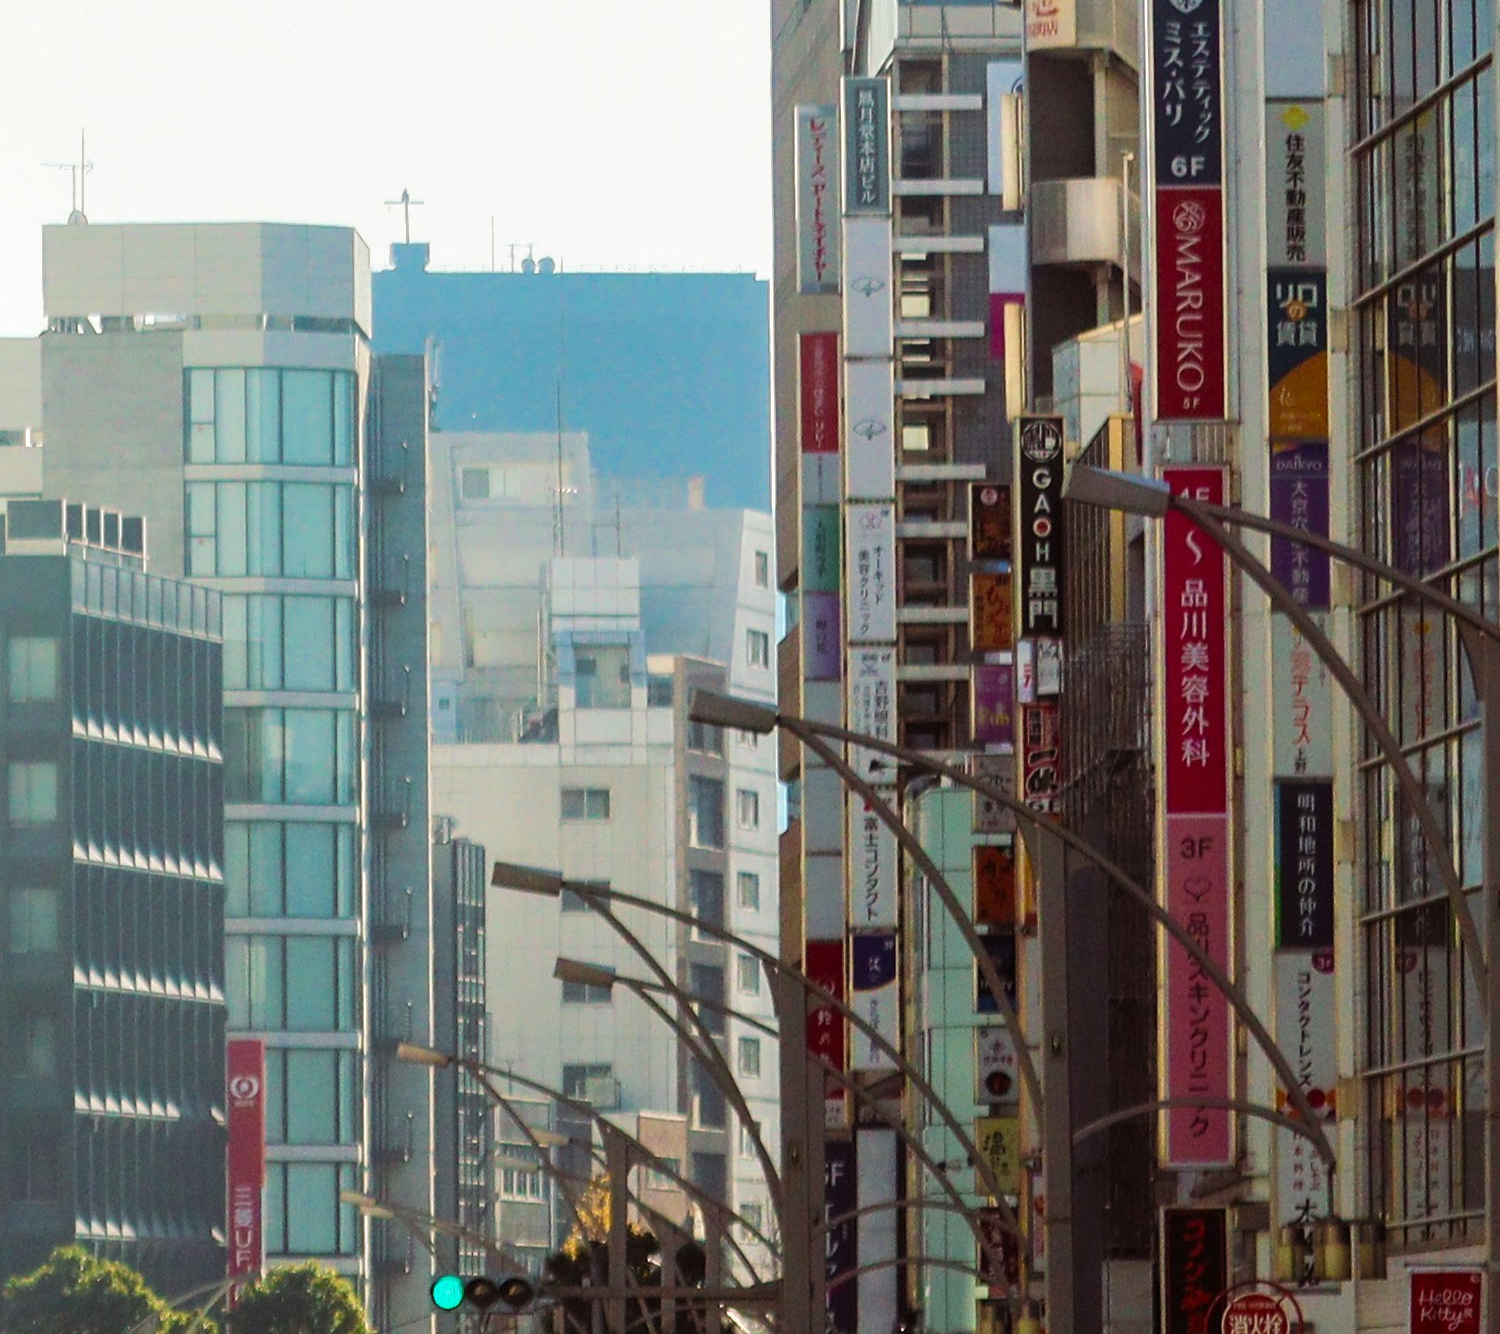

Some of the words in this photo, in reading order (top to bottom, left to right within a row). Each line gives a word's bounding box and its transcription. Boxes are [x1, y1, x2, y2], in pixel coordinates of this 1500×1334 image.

[1161, 22, 1184, 128] ミス・パリ
[1192, 21, 1213, 145] エステティック
[1170, 155, 1206, 178] 6F
[1284, 133, 1307, 263] 住友不動産販売
[1175, 235, 1205, 394] MARUKO
[1276, 321, 1318, 348] 賃貸
[1027, 568, 1059, 630] 黒門
[1180, 578, 1210, 768] 品川美容外科
[1180, 836, 1215, 860] 3F
[1296, 793, 1316, 936] 明和地所の仲介
[1296, 973, 1314, 1088] コンタクトレンズ
[1419, 1288, 1475, 1308] Hello
[1420, 1306, 1463, 1332] Kitty
